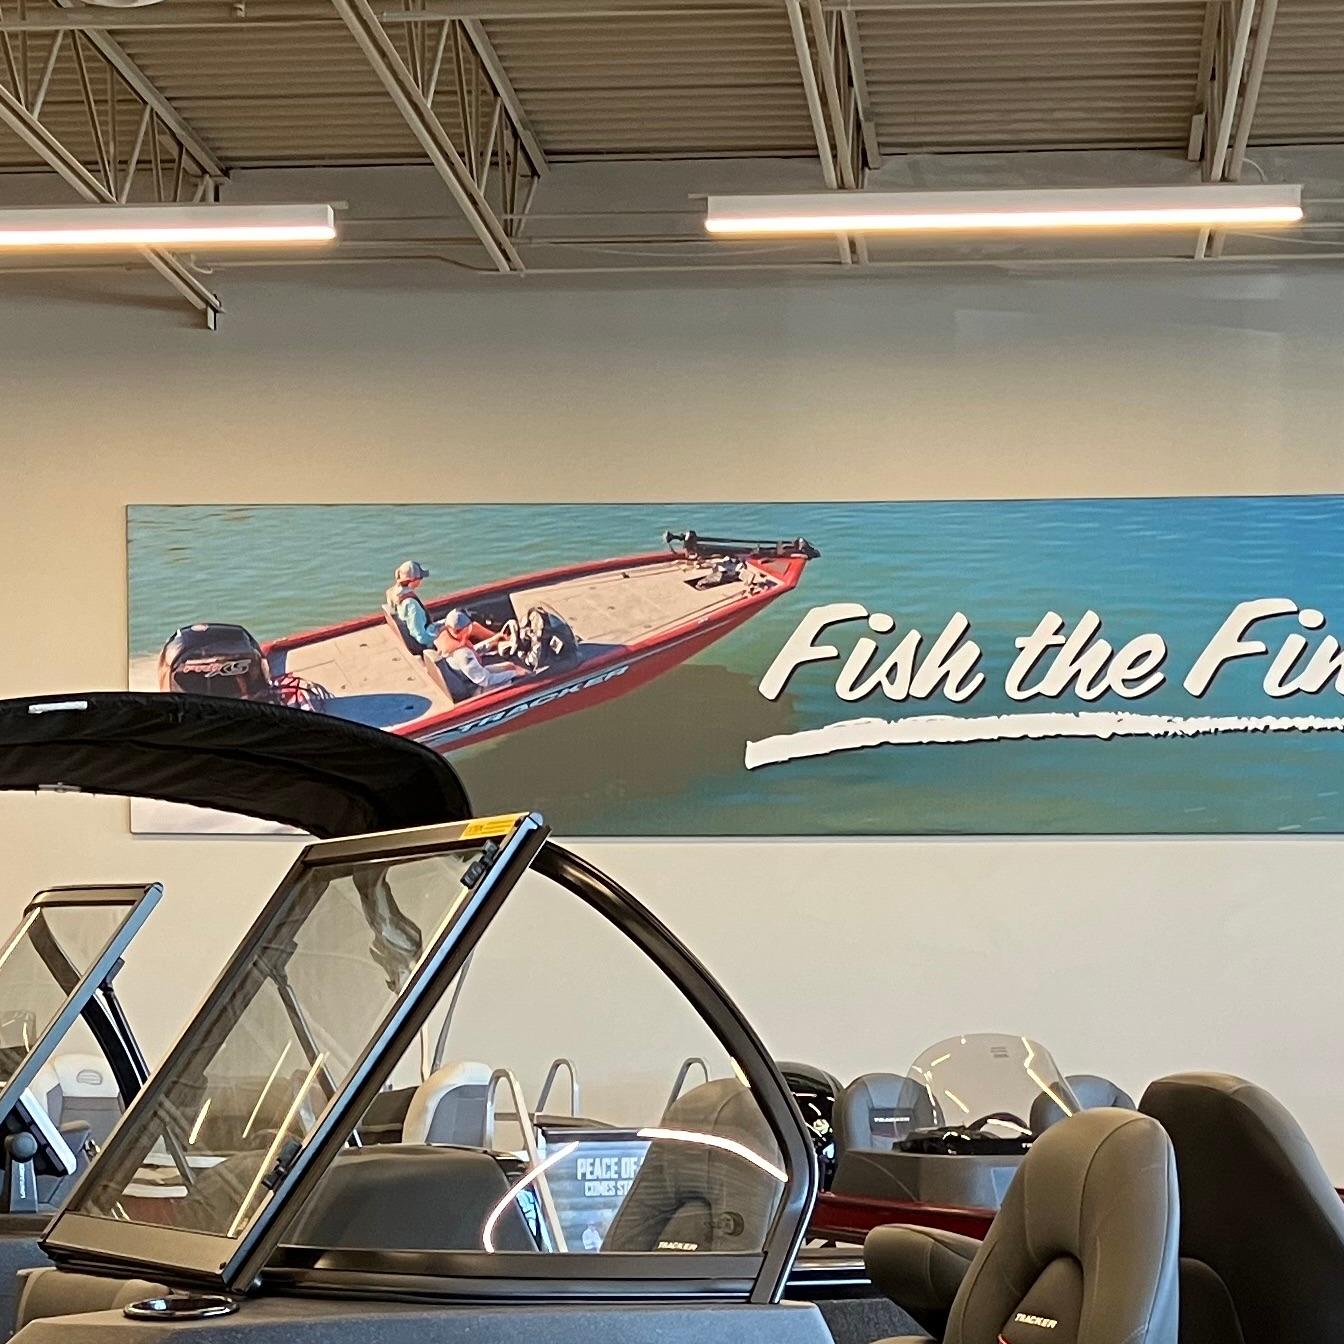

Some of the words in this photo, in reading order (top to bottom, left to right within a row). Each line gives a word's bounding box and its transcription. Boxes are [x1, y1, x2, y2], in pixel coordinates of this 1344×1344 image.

[759, 601, 987, 702] Fish
[1005, 609, 1167, 702] the
[576, 1156, 619, 1180] PEACE
[620, 1156, 637, 1179] OF
[584, 1180, 616, 1197] COMES
